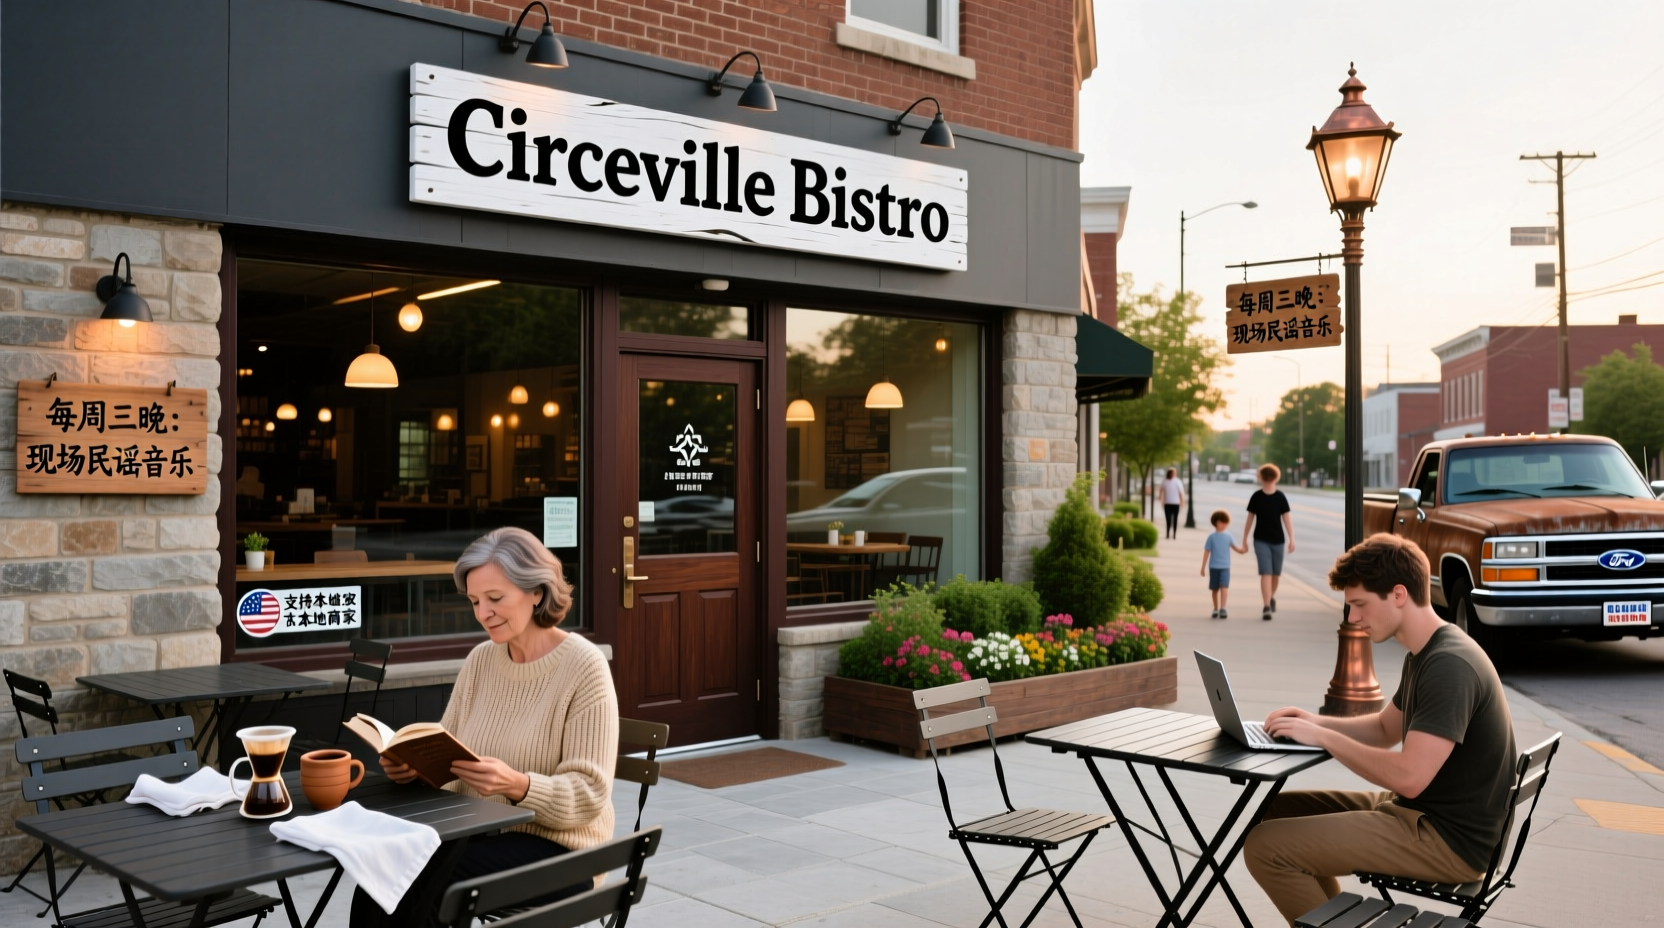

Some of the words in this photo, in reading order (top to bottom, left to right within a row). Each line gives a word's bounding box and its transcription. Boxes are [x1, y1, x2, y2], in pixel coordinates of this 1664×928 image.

[447, 97, 776, 217] Circeville
[789, 158, 950, 244] Bistro
[45, 396, 180, 434] 每周三晚：
[25, 443, 194, 479] 现场民谣音乐
